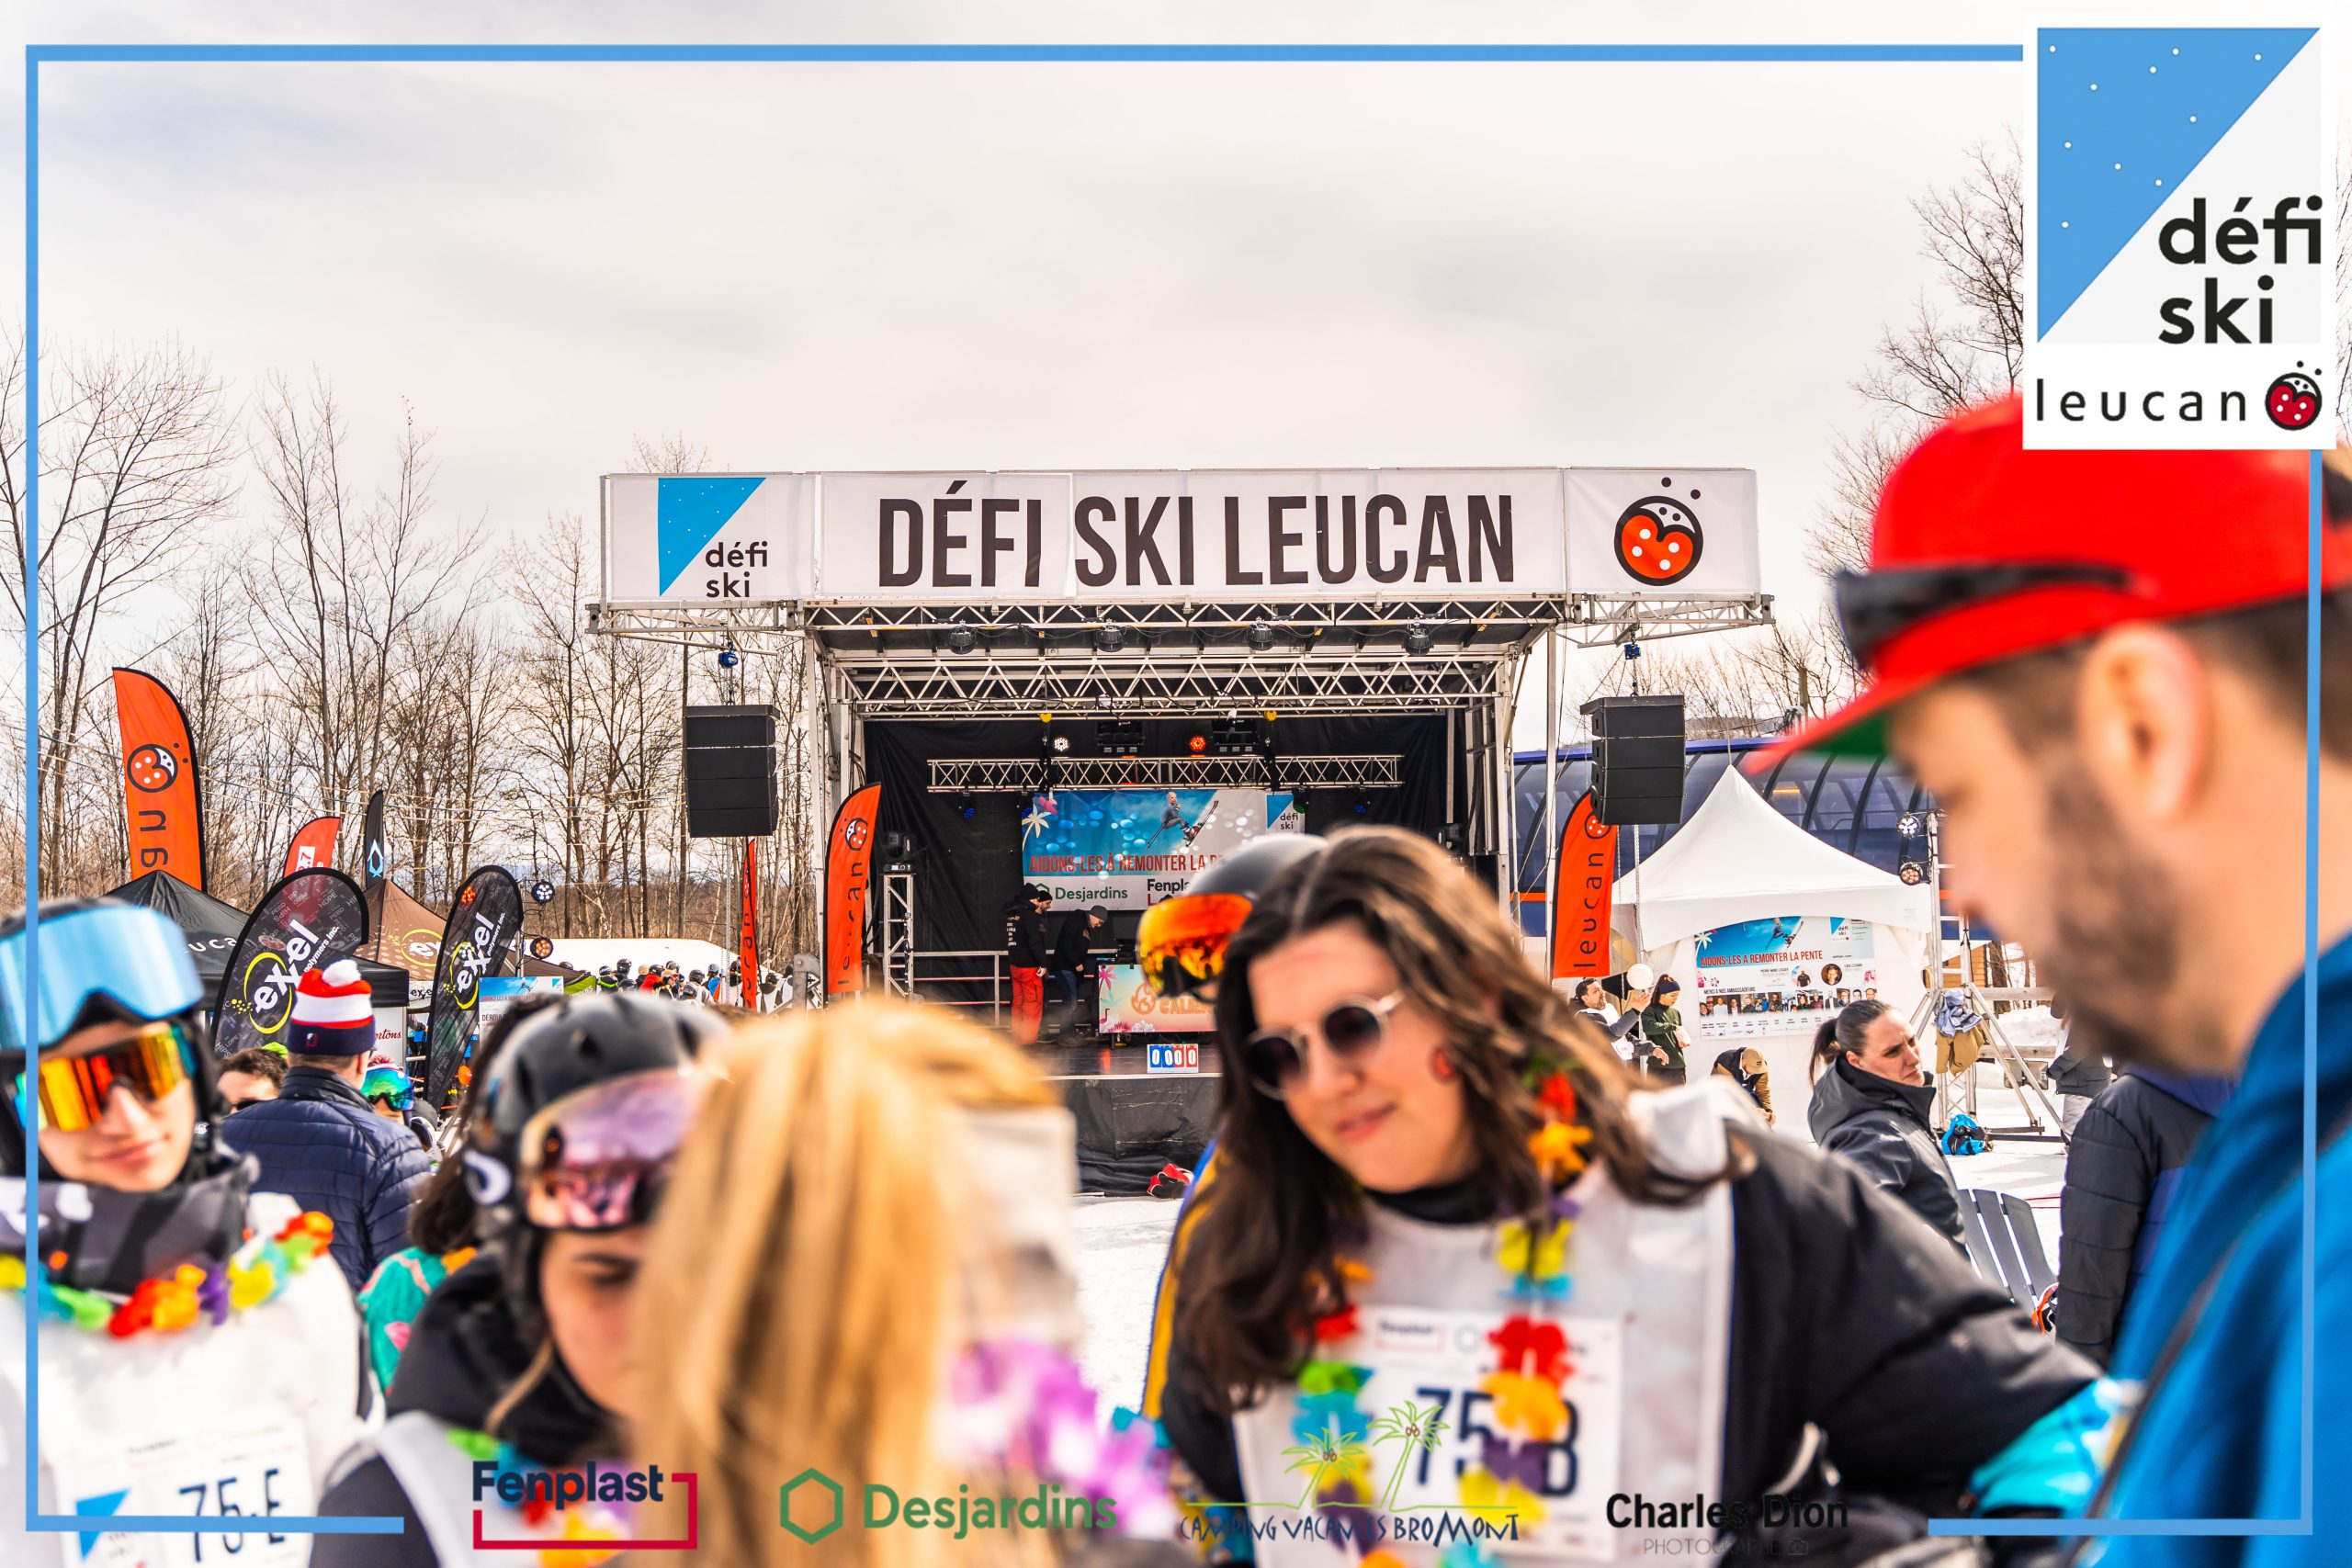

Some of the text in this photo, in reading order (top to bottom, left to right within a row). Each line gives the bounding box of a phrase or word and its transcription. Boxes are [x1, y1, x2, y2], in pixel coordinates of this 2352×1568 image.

[878, 480, 1514, 587] DÉFI SKI LEUCAN
[705, 541, 767, 568] défi
[706, 571, 751, 598] ski
[1280, 812, 1298, 820] défi
[1280, 821, 1294, 829] ski
[1030, 855, 1104, 873] AIDONS-LES
[1107, 852, 1115, 872] À
[1118, 854, 1186, 872] REMONTER
[1190, 854, 1205, 871] LA
[1055, 886, 1128, 903] Desjardins
[1147, 878, 1191, 894] Fenpl
[1574, 852, 1604, 967] leucan
[1701, 953, 1742, 966] AIDONS-LES
[1750, 951, 1788, 964] REMONTER
[1790, 950, 1800, 962] LA
[1801, 950, 1824, 961] PENTE
